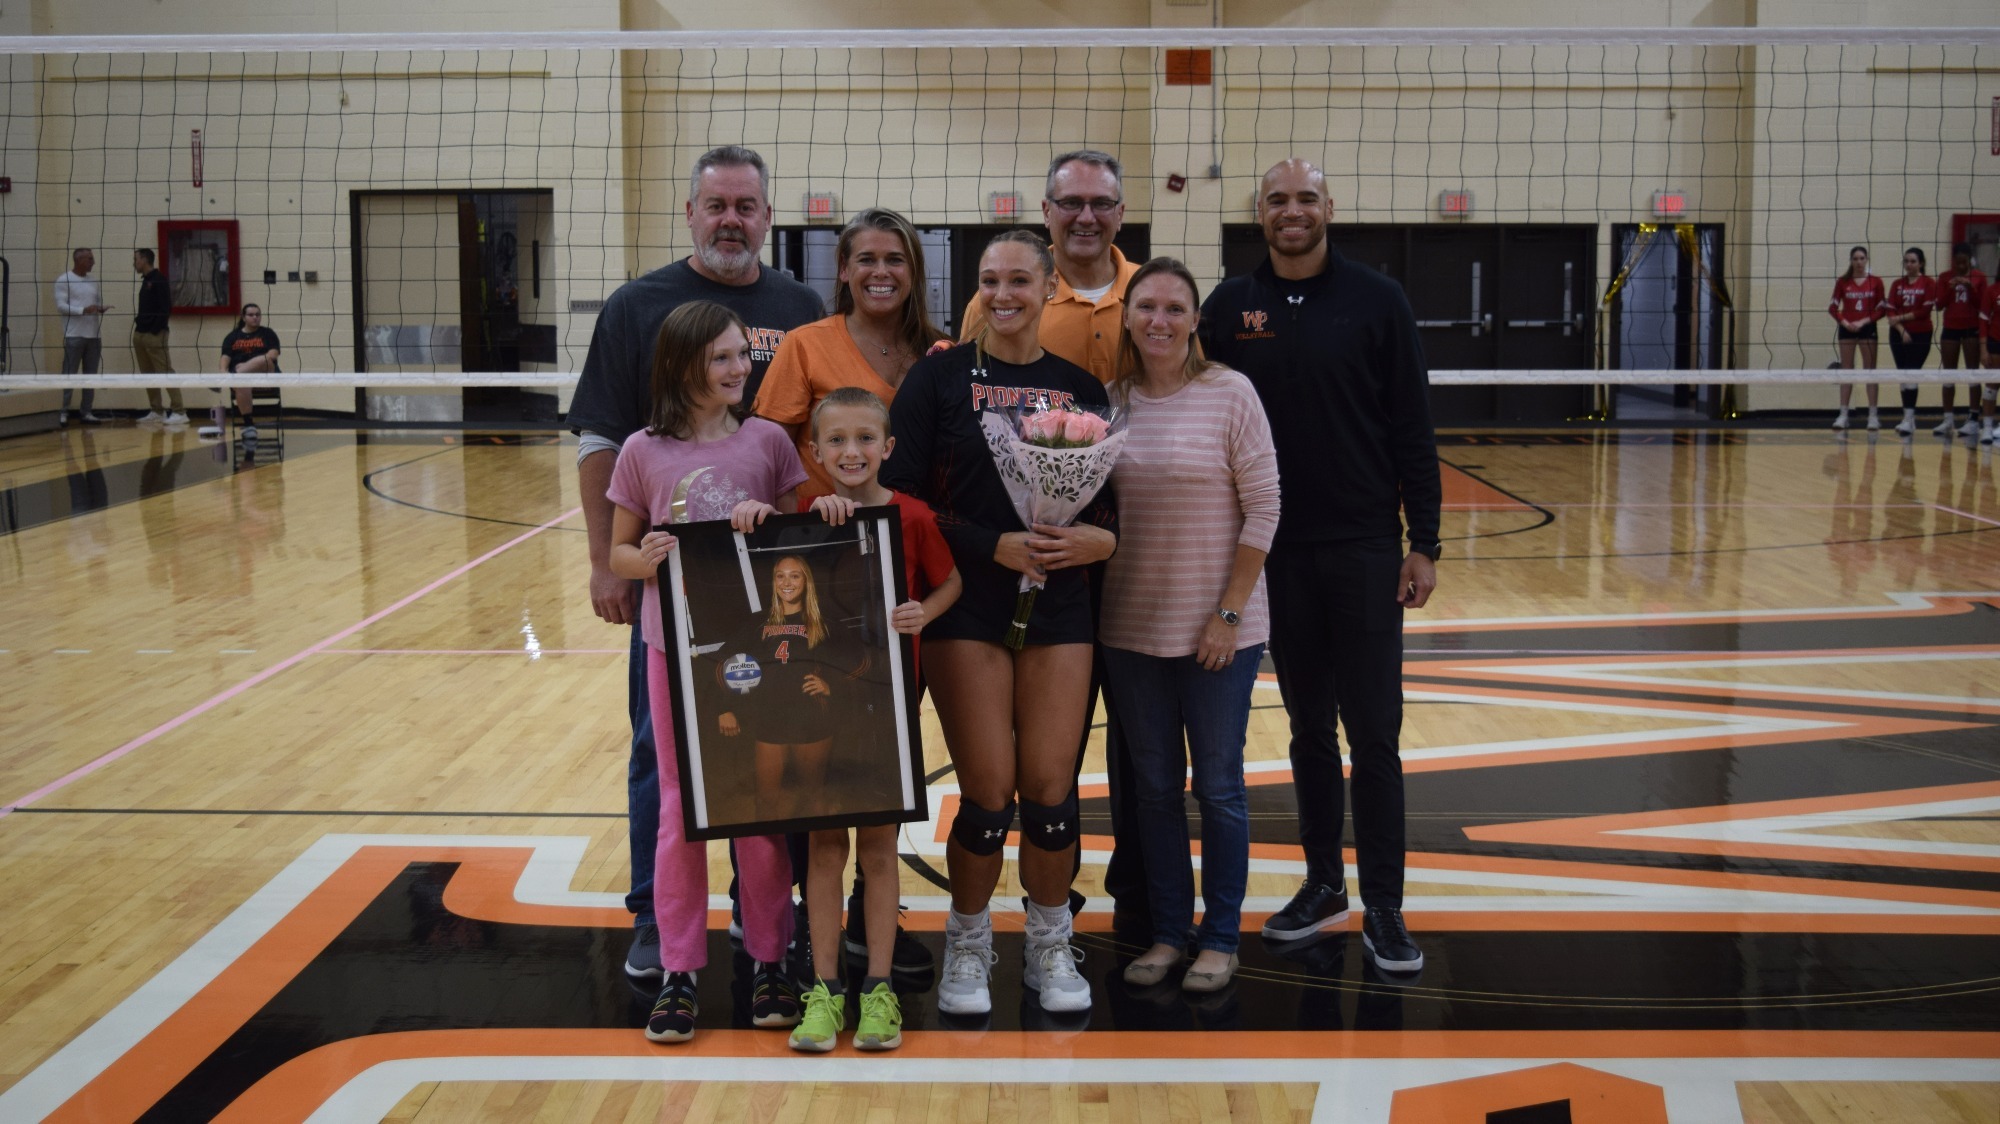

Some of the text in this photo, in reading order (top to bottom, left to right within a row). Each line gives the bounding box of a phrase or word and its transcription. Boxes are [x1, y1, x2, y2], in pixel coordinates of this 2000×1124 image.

[1902, 294, 1915, 307] 21
[1955, 291, 1967, 303] 14
[971, 383, 1075, 413] PIONEERS
[774, 640, 790, 665] 4
[730, 662, 756, 671] molten
